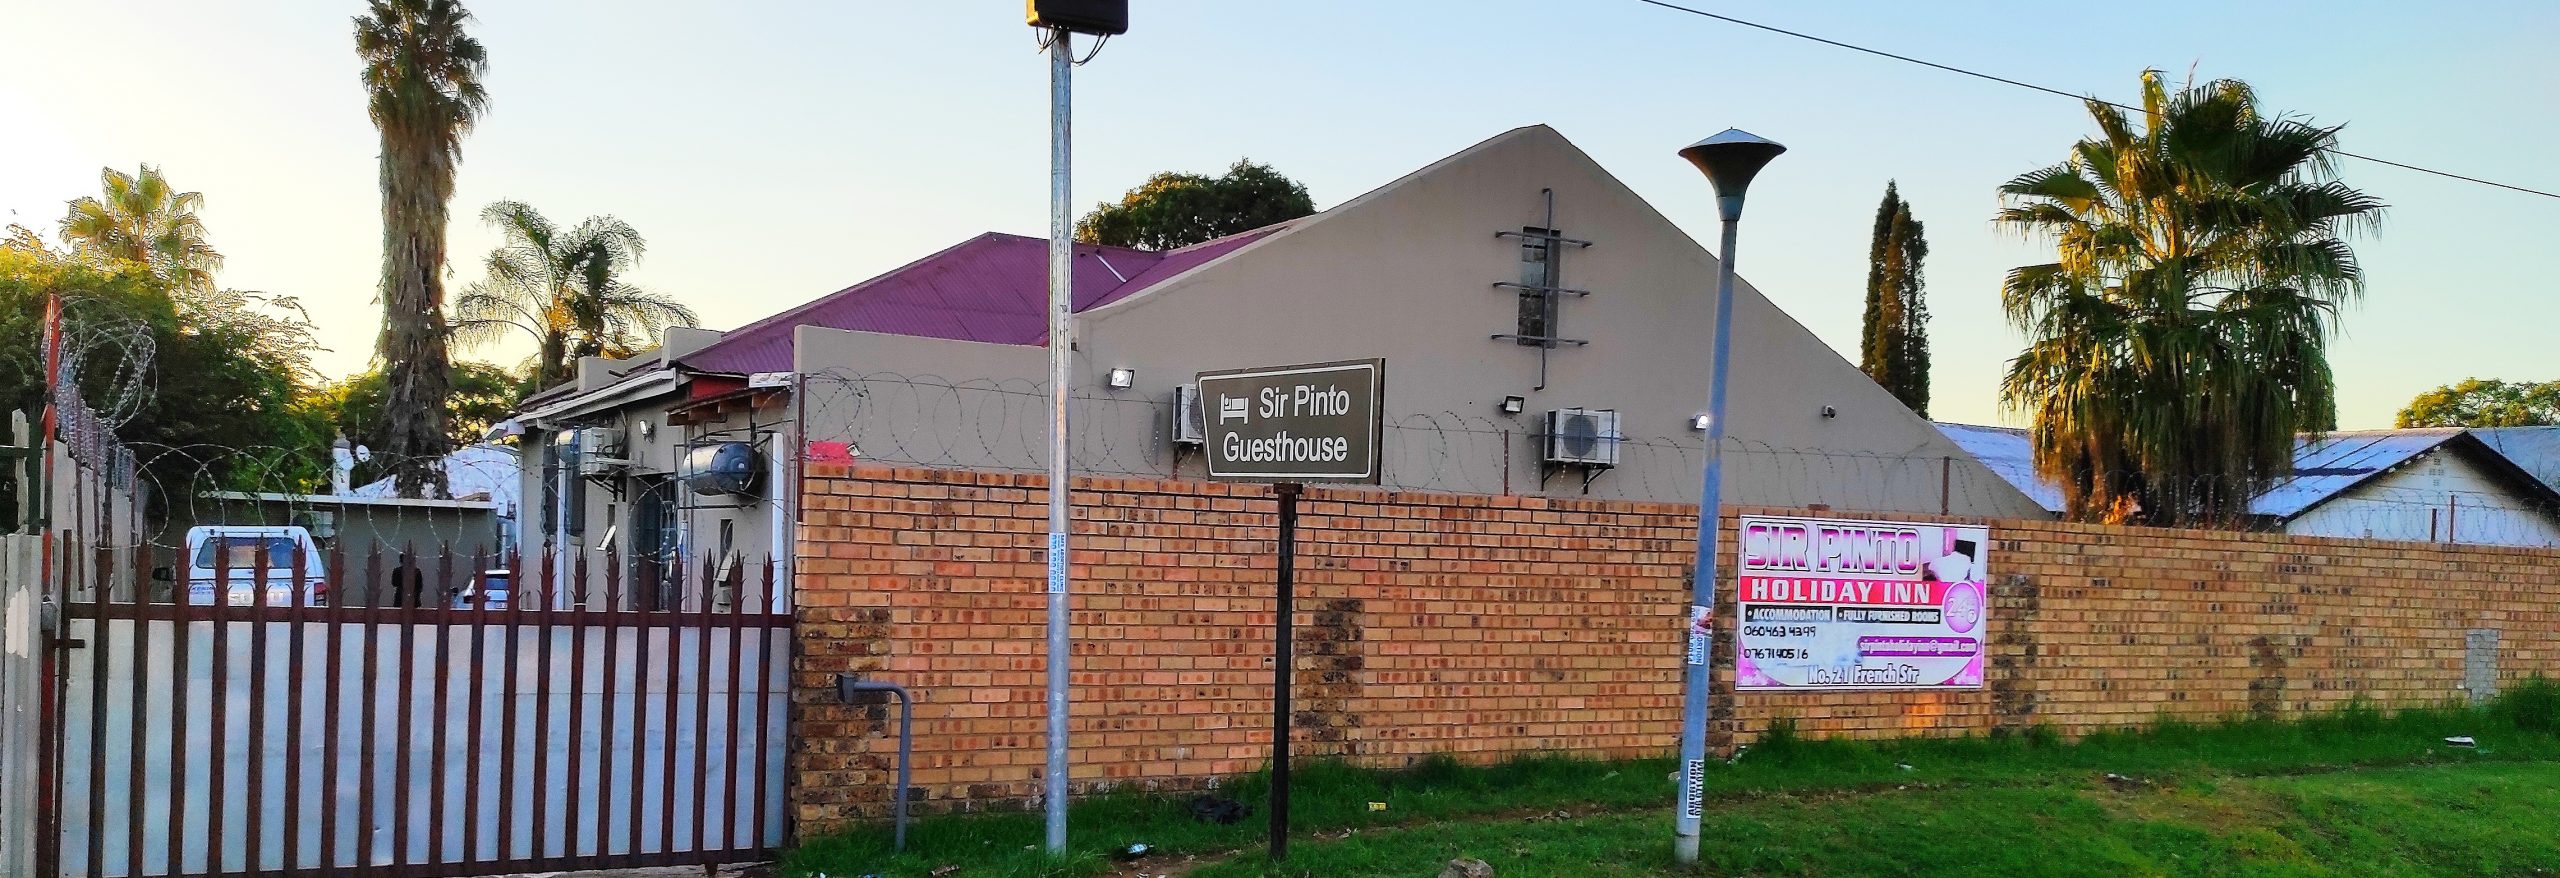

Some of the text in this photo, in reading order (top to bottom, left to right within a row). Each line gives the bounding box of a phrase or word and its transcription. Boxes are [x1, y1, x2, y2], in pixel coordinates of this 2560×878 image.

[1259, 384, 1350, 418] Sir Pinto
[1223, 431, 1348, 462] Guesthouse
[1744, 521, 1921, 574] SIR PINTO
[1751, 578, 1931, 604] HOLIDAY INN
[1753, 608, 1831, 621] ACCOMMODATION
[1843, 610, 1939, 622] FULLY FURNISHED ROOMS
[1808, 663, 1920, 684] No. 21 French Str
[1688, 761, 1697, 816] ABORTION
